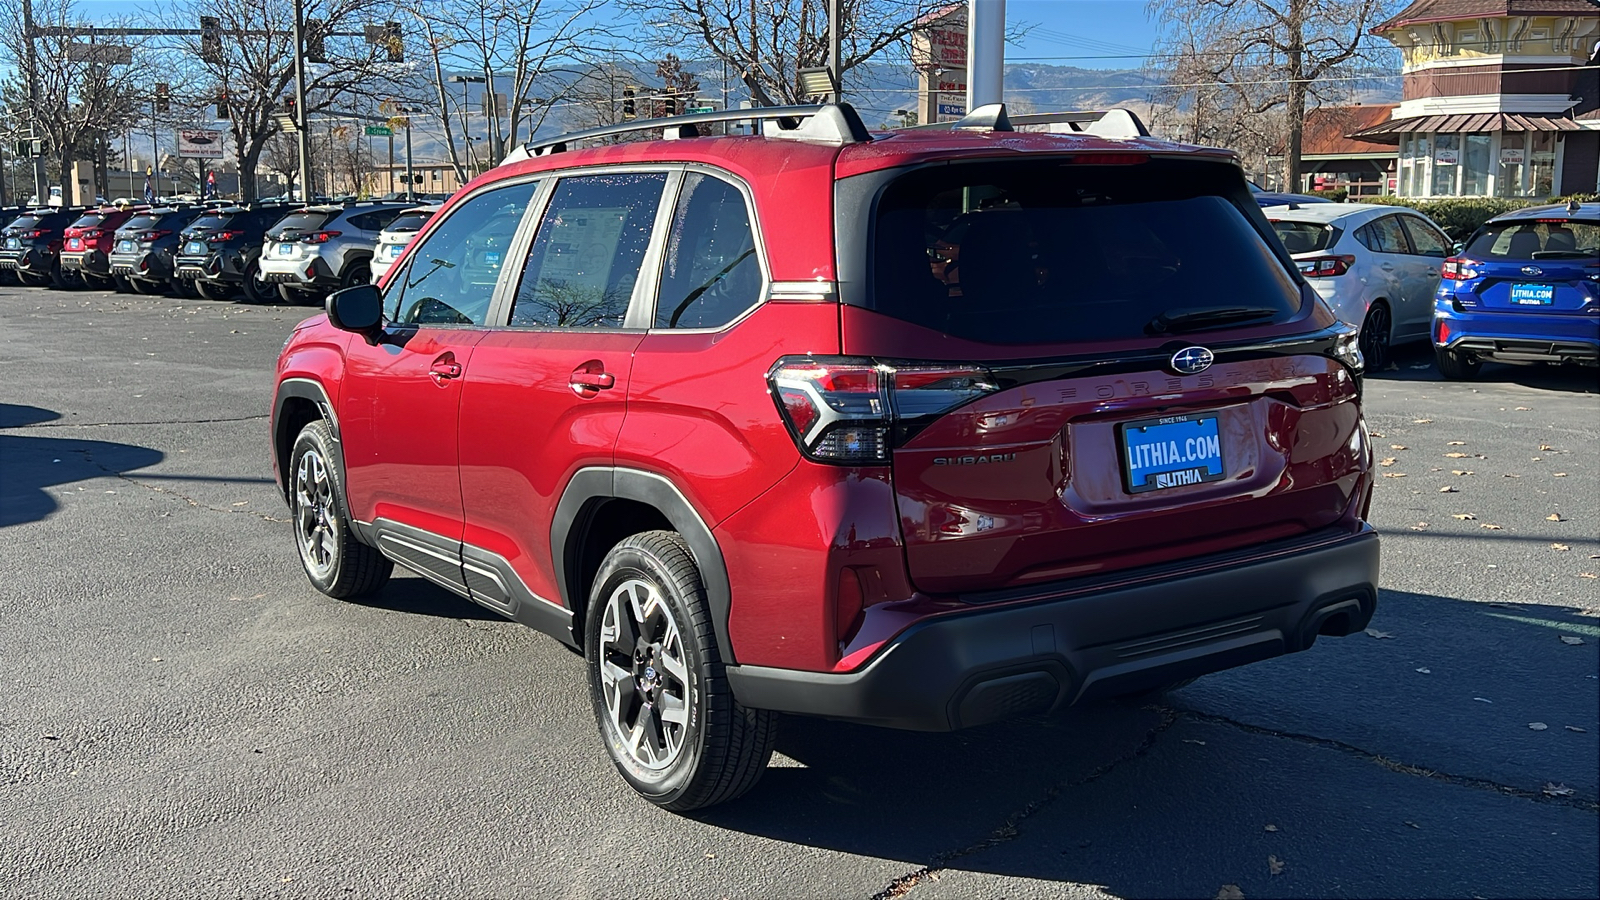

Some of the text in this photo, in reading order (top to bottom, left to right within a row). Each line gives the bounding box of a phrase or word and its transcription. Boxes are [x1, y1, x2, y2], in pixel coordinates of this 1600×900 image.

[1512, 289, 1552, 299] LITHIA.COM
[1159, 416, 1174, 424] SINCE
[1128, 434, 1220, 470] LITHIA.COM
[933, 453, 1016, 466] SUBARU
[1166, 469, 1202, 487] LITHIA
